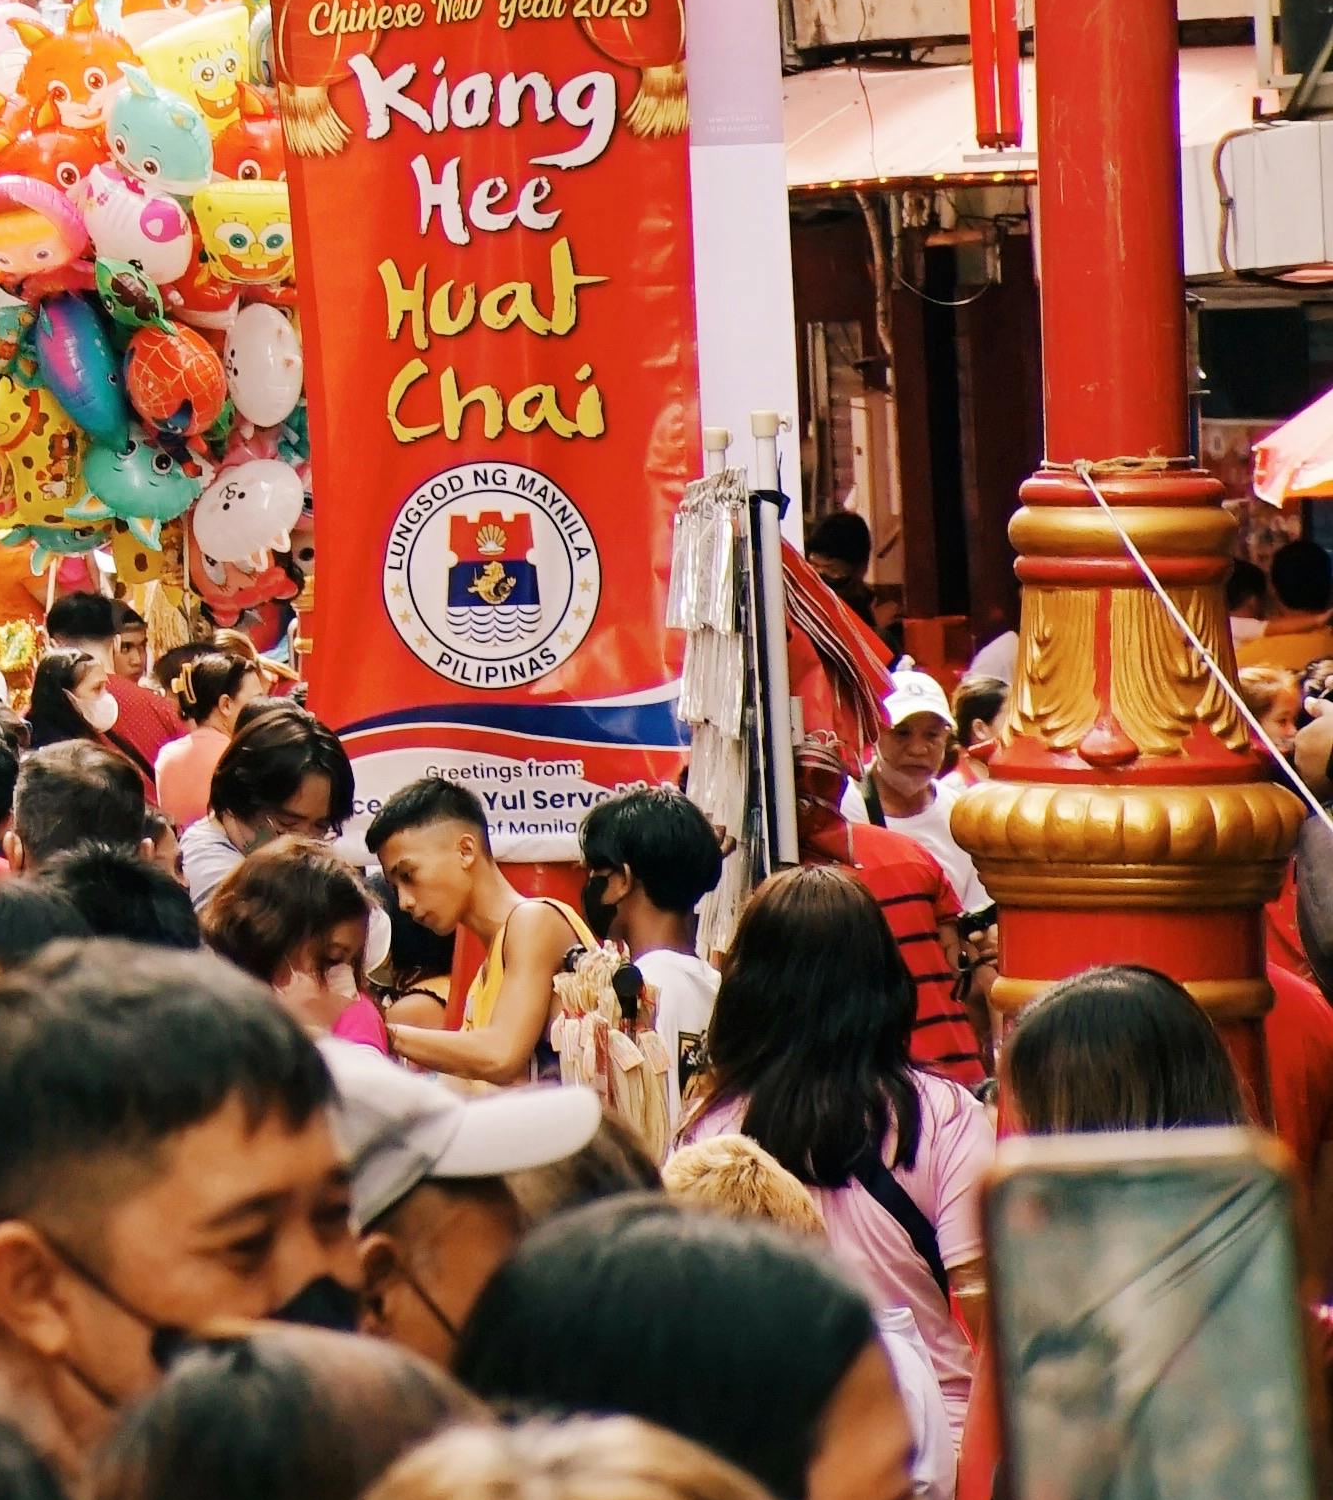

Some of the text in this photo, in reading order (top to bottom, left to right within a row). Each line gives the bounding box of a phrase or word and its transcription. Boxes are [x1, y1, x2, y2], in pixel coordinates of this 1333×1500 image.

[347, 53, 617, 169] Kiang
[410, 153, 564, 246] Hee
[376, 236, 611, 351] Huat
[386, 357, 606, 443] Chai
[388, 467, 593, 573] LUNGSOD NG MAYNILA
[436, 647, 558, 685] PILIPINAS
[425, 758, 583, 782] Greetings from:
[483, 789, 526, 812] Yul
[508, 818, 578, 836] Manila
